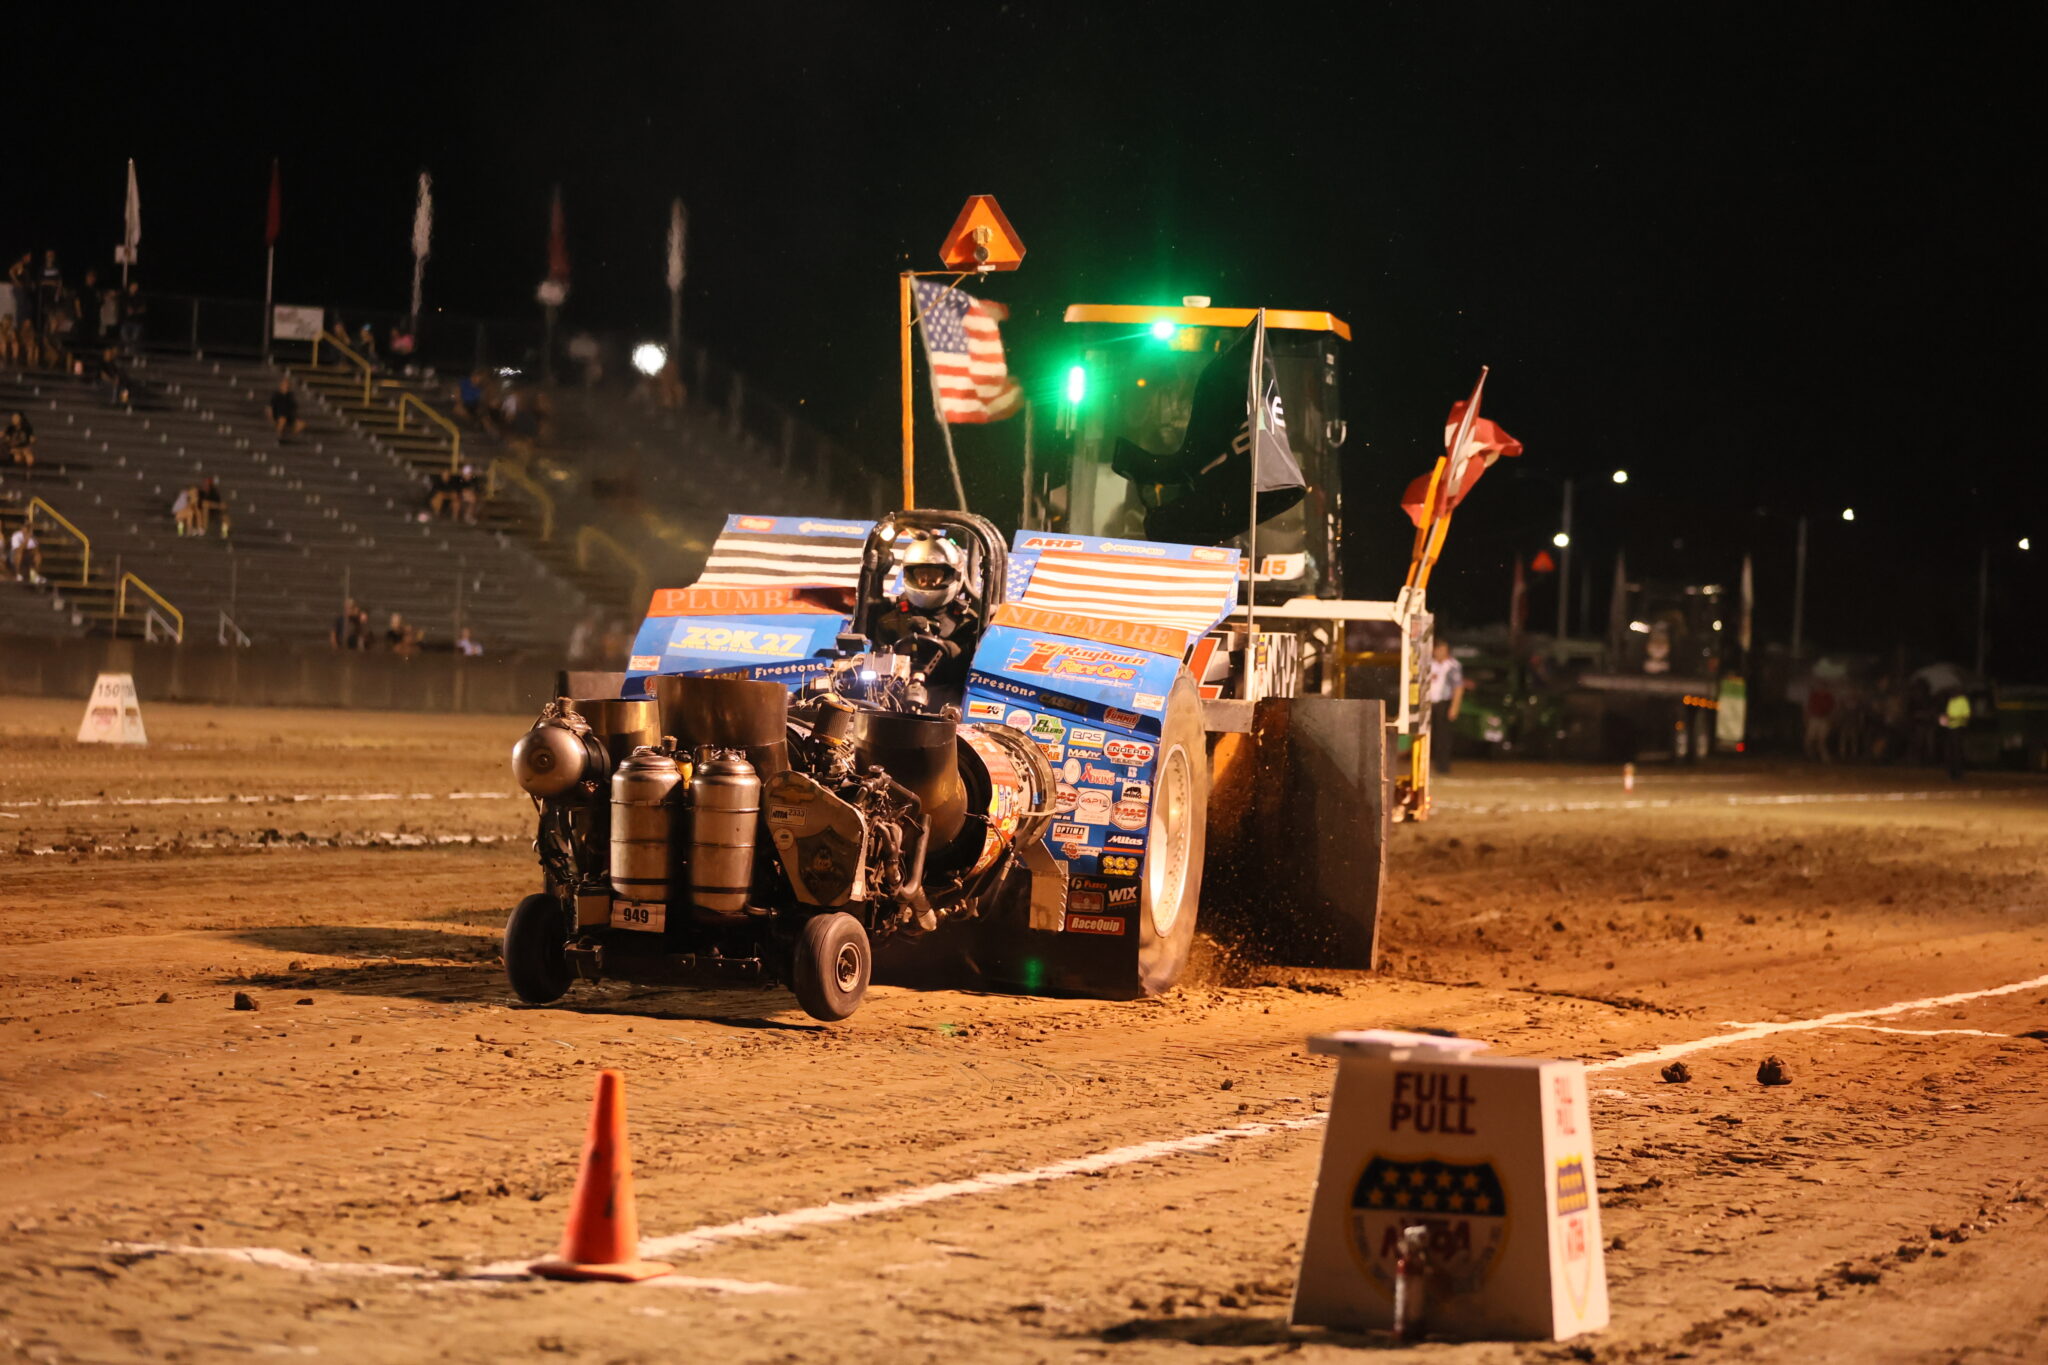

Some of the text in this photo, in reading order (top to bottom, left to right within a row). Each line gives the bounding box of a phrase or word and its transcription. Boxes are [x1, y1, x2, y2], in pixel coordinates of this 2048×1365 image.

[1024, 538, 1082, 549] ARP
[1003, 606, 1174, 648] NITEMARE
[683, 626, 759, 649] ZOK
[757, 633, 803, 653] 27
[1062, 645, 1148, 667] Rayburn
[755, 662, 825, 679] Firestone
[969, 672, 1036, 697] Firestone
[1072, 730, 1102, 742] BRS
[1056, 825, 1085, 835] OPTIMA
[1108, 886, 1137, 903] WIX
[623, 907, 649, 924] 949
[1071, 917, 1120, 932] RaceQuip
[1394, 1071, 1477, 1105] FULL
[1390, 1103, 1477, 1136] PULL
